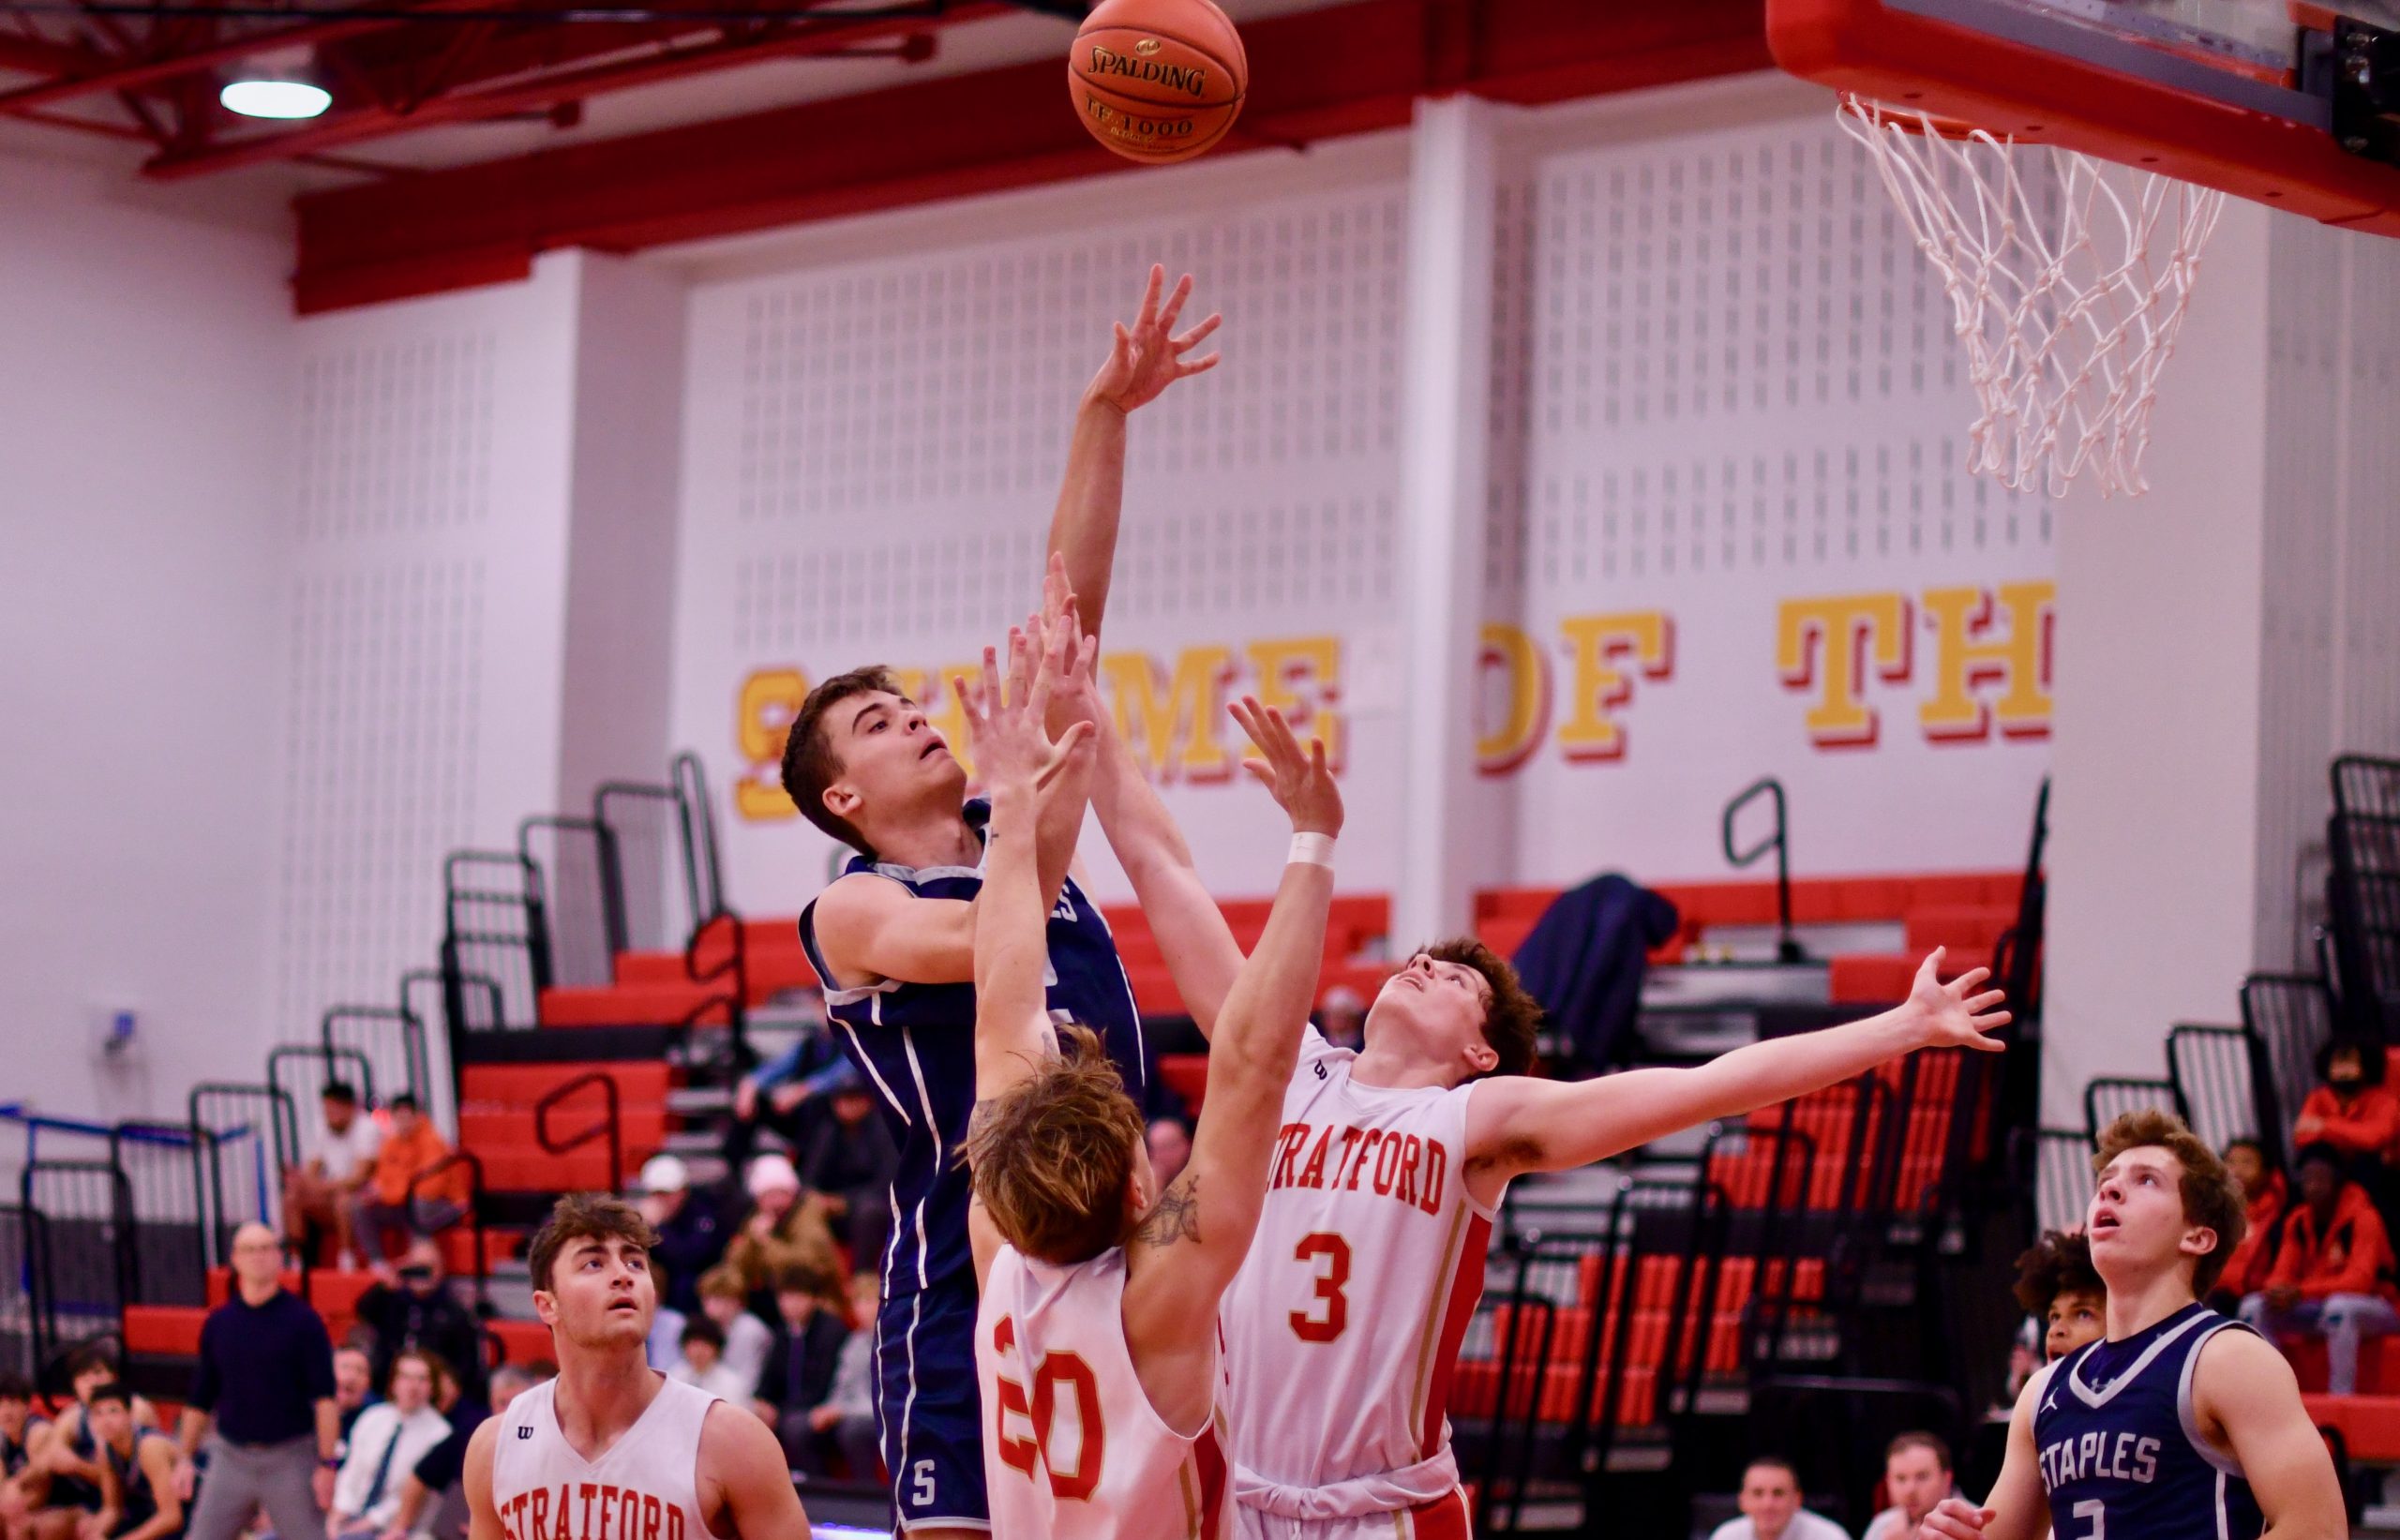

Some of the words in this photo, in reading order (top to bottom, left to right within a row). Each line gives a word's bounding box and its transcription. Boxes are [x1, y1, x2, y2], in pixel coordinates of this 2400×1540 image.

[1088, 45, 1206, 97] SPALDING
[1266, 1122, 1447, 1217] TRATFORD
[1288, 1231, 1351, 1344] 3
[912, 1459, 936, 1505] S
[2039, 1430, 2161, 1497] STAPLES
[501, 1483, 684, 1540] STRATFORD
